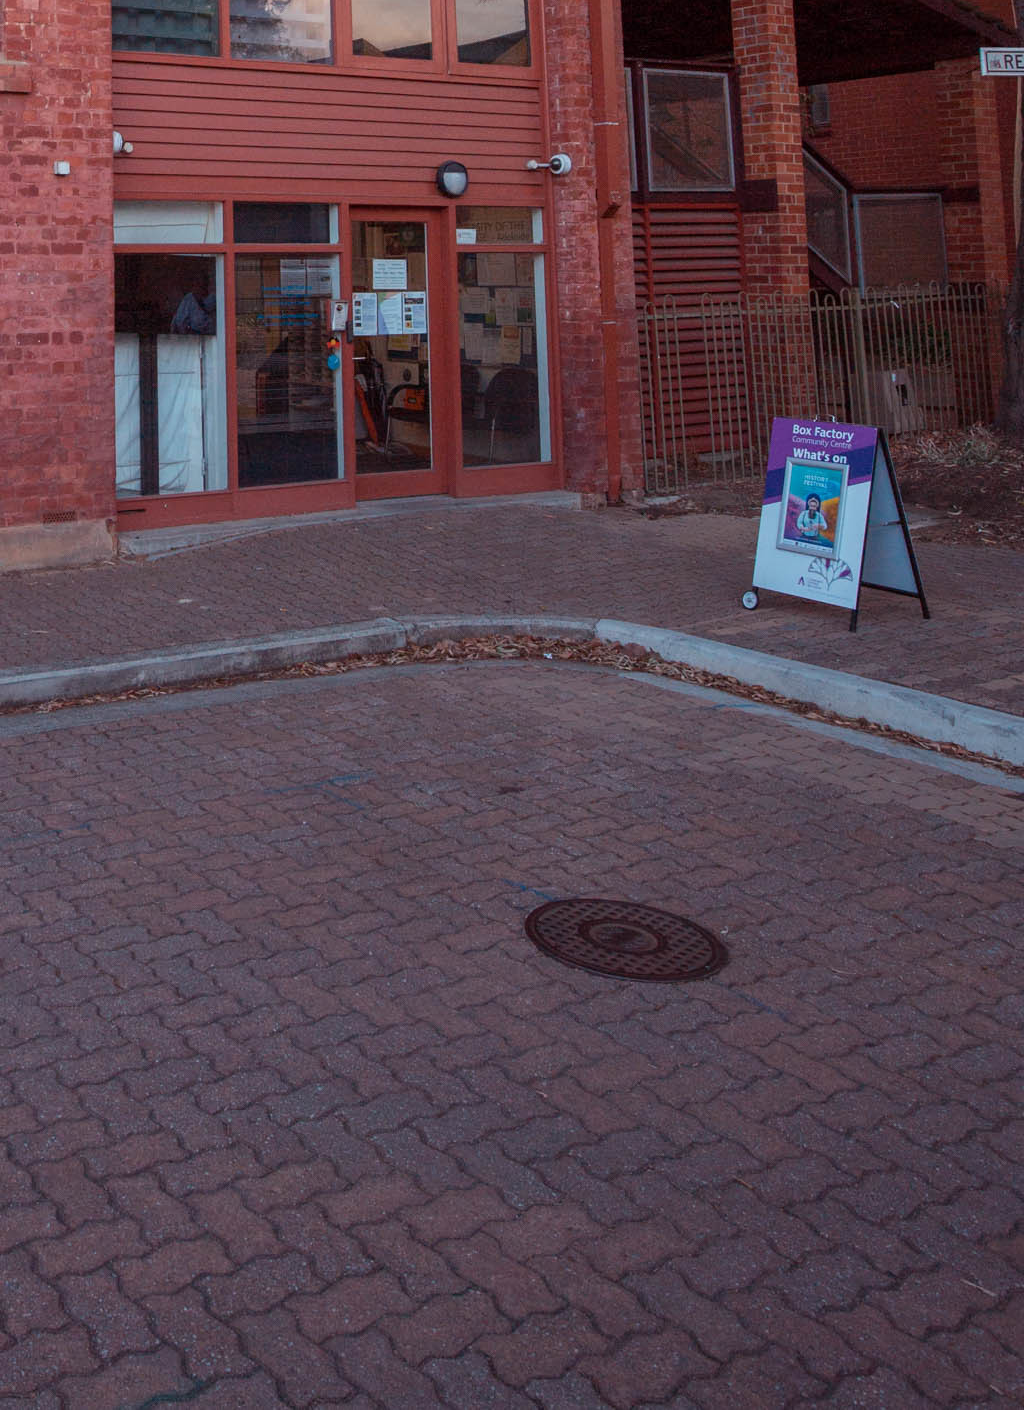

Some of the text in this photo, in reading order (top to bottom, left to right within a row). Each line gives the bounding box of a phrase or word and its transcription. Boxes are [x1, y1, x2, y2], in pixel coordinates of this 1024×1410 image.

[792, 424, 854, 443] Box Factory
[792, 435, 853, 450] Community Centre
[793, 447, 848, 464] What's on
